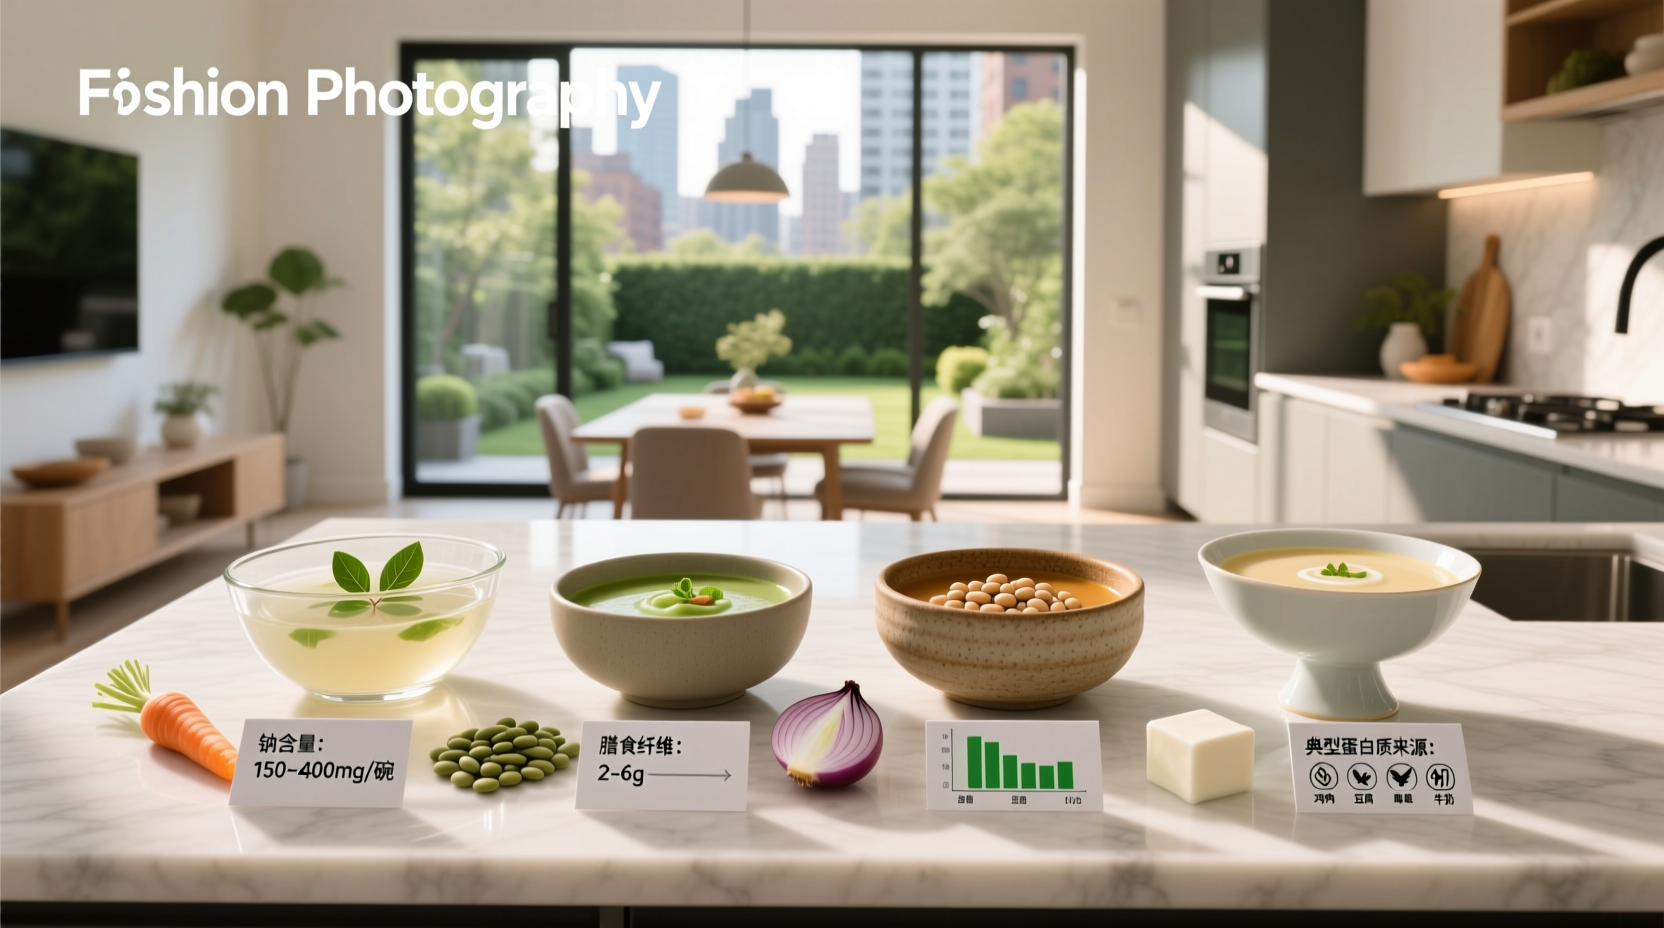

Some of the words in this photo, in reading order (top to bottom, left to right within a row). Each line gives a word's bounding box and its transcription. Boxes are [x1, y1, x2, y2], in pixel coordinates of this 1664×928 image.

[599, 735, 682, 756] 膳食纤维：
[598, 764, 644, 787] 2-6g
